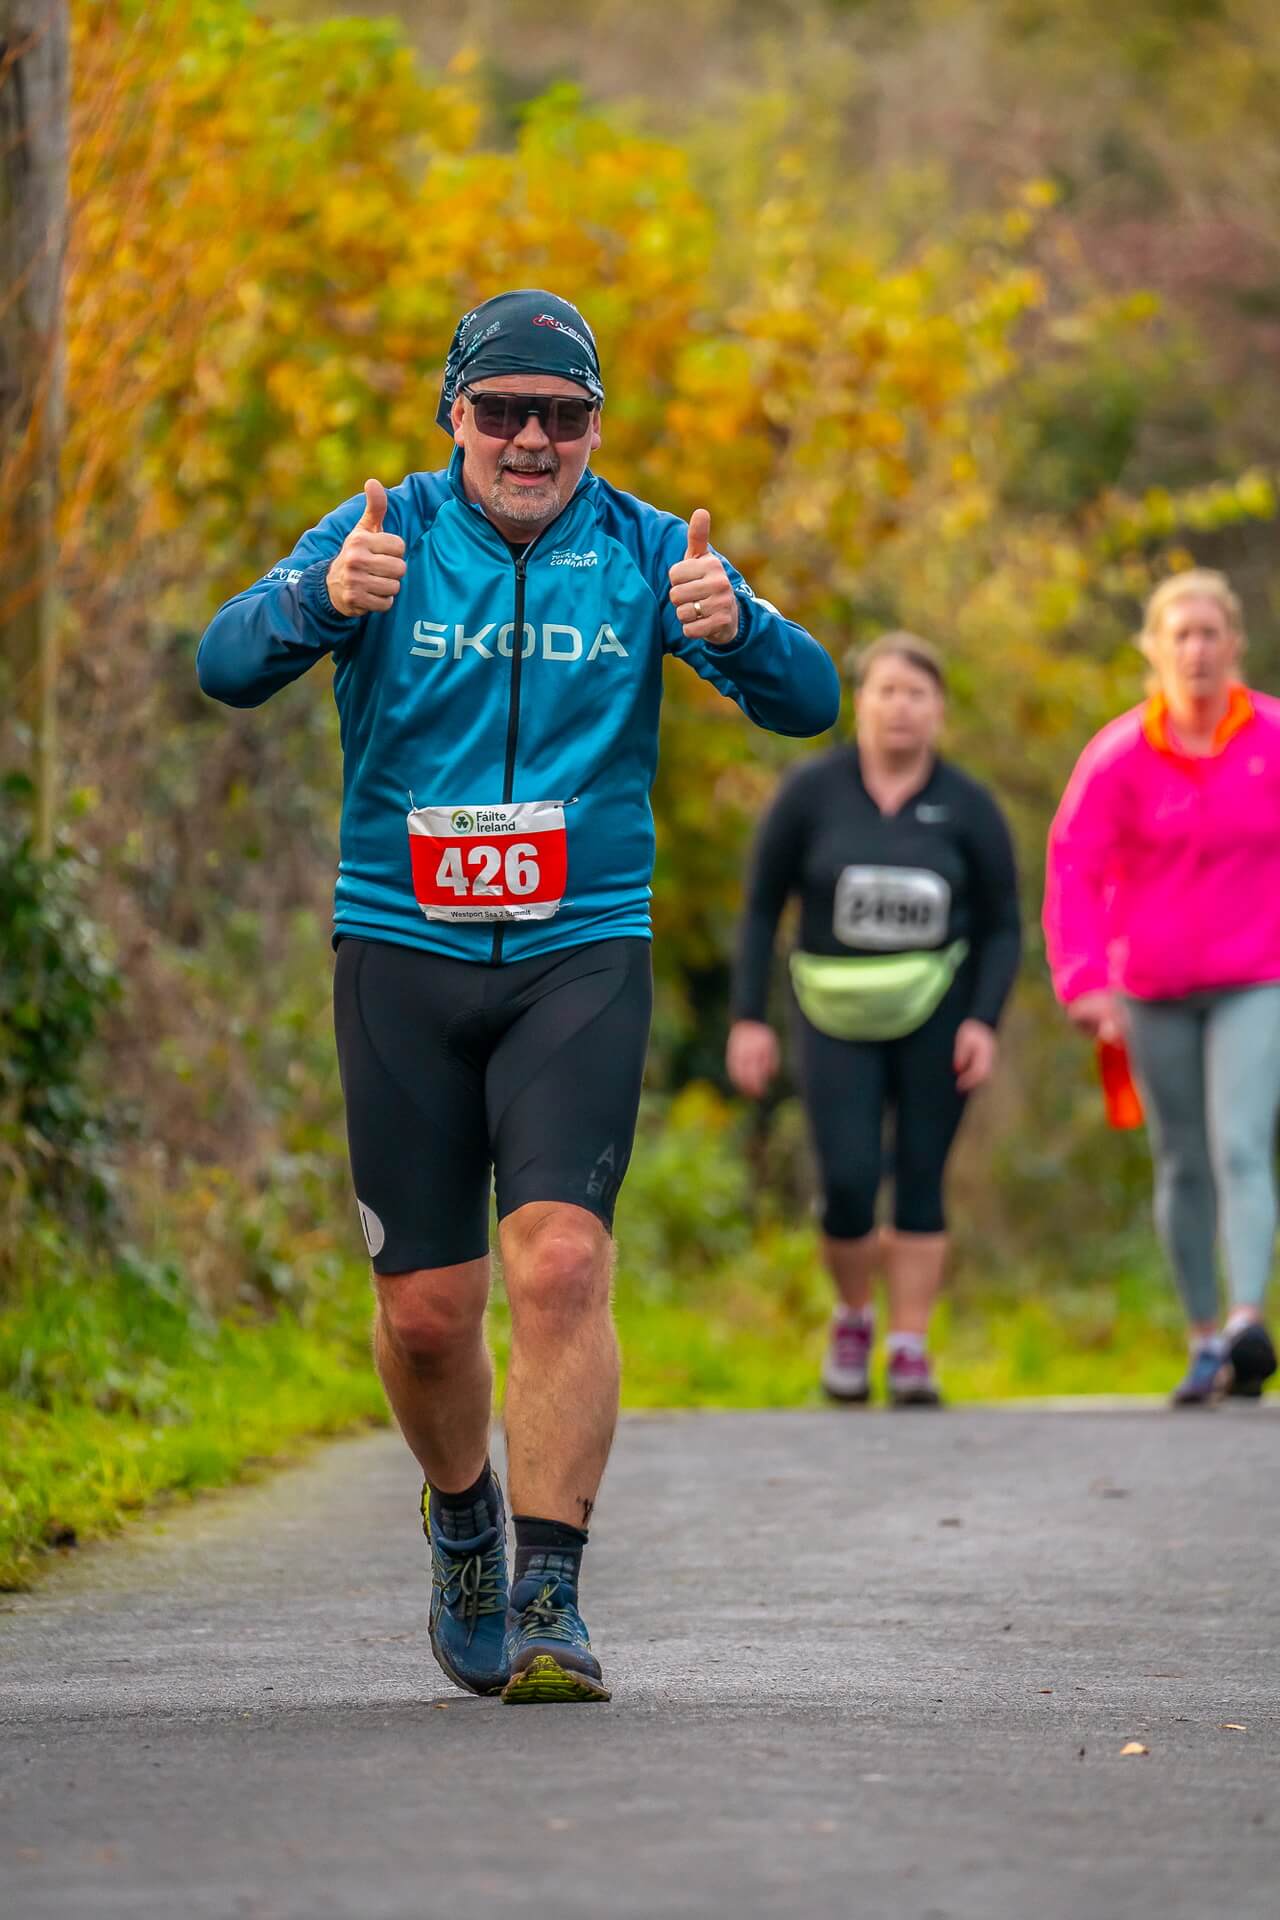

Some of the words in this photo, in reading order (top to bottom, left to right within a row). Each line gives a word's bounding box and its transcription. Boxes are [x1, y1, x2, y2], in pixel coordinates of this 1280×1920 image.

[409, 620, 629, 661] SKODA
[476, 811, 506, 821] Fáilte
[477, 821, 515, 832] Ireland
[435, 843, 540, 896] 426
[505, 909, 531, 917] Summit
